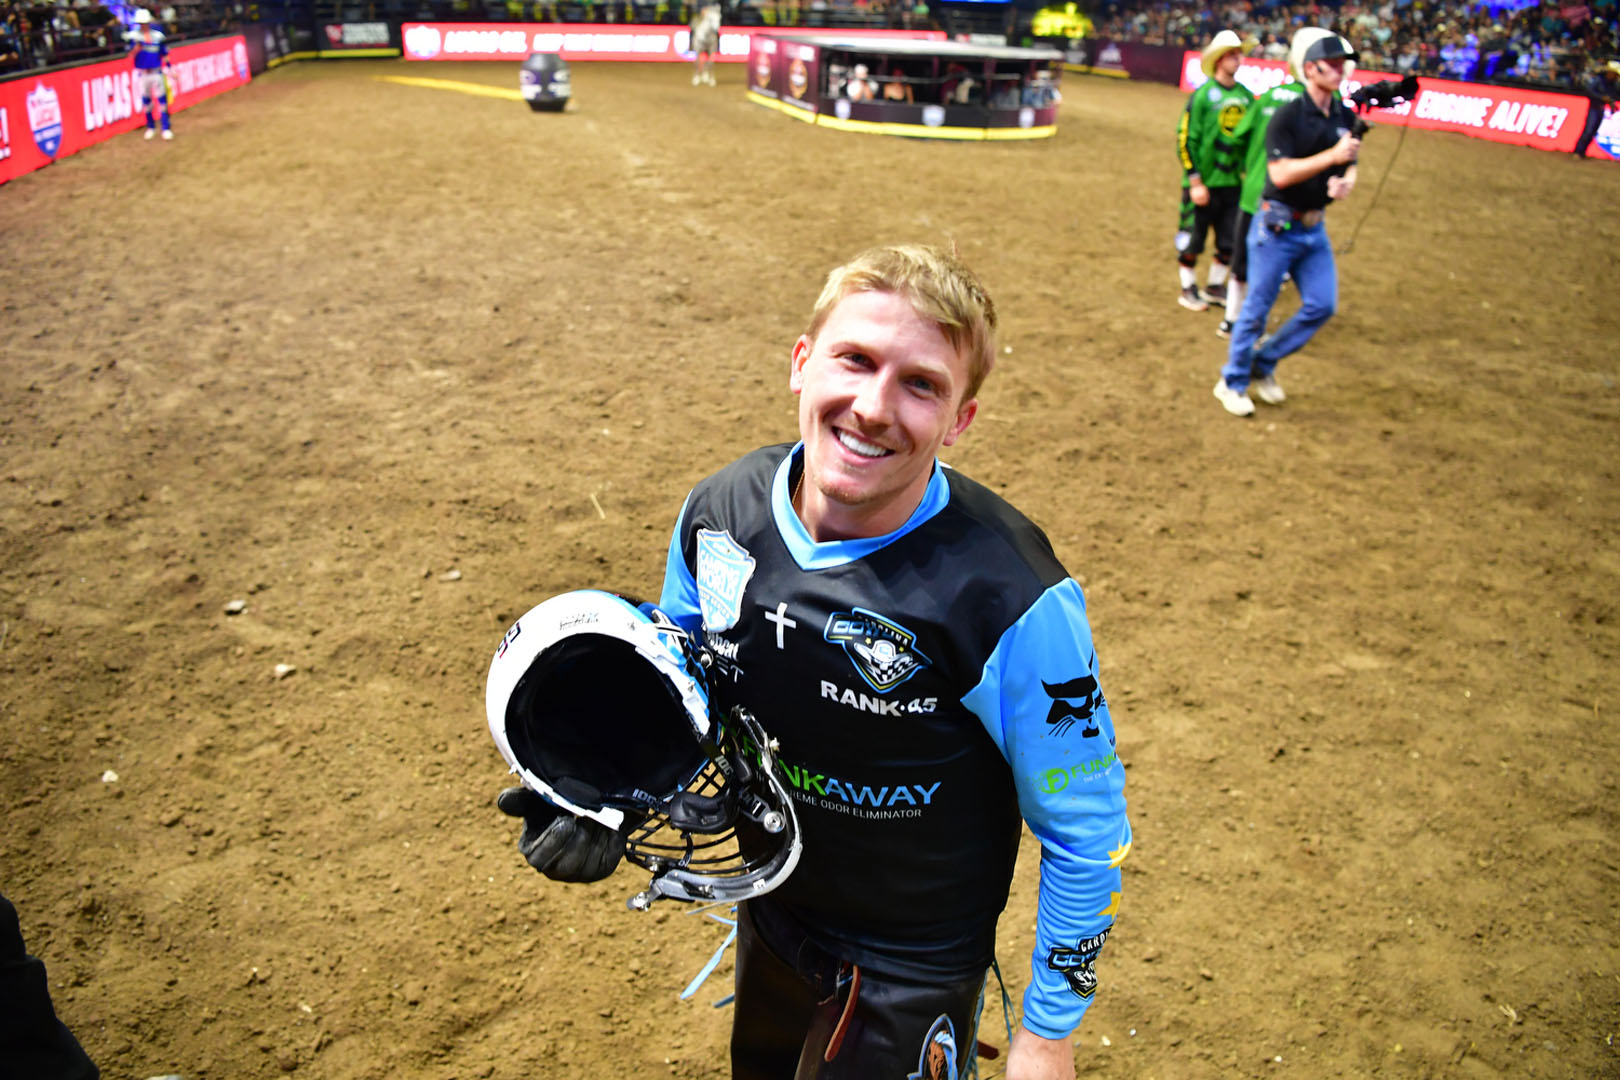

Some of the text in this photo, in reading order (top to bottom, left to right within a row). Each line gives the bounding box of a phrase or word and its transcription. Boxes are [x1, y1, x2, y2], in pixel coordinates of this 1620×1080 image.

[82, 71, 132, 131] LUCAS
[1414, 90, 1493, 128] ENGINE
[1487, 100, 1568, 139] ALIVE!
[742, 734, 943, 808] FNKAWAY
[820, 800, 850, 815] ODOR
[852, 807, 923, 820] ELIMINATOR
